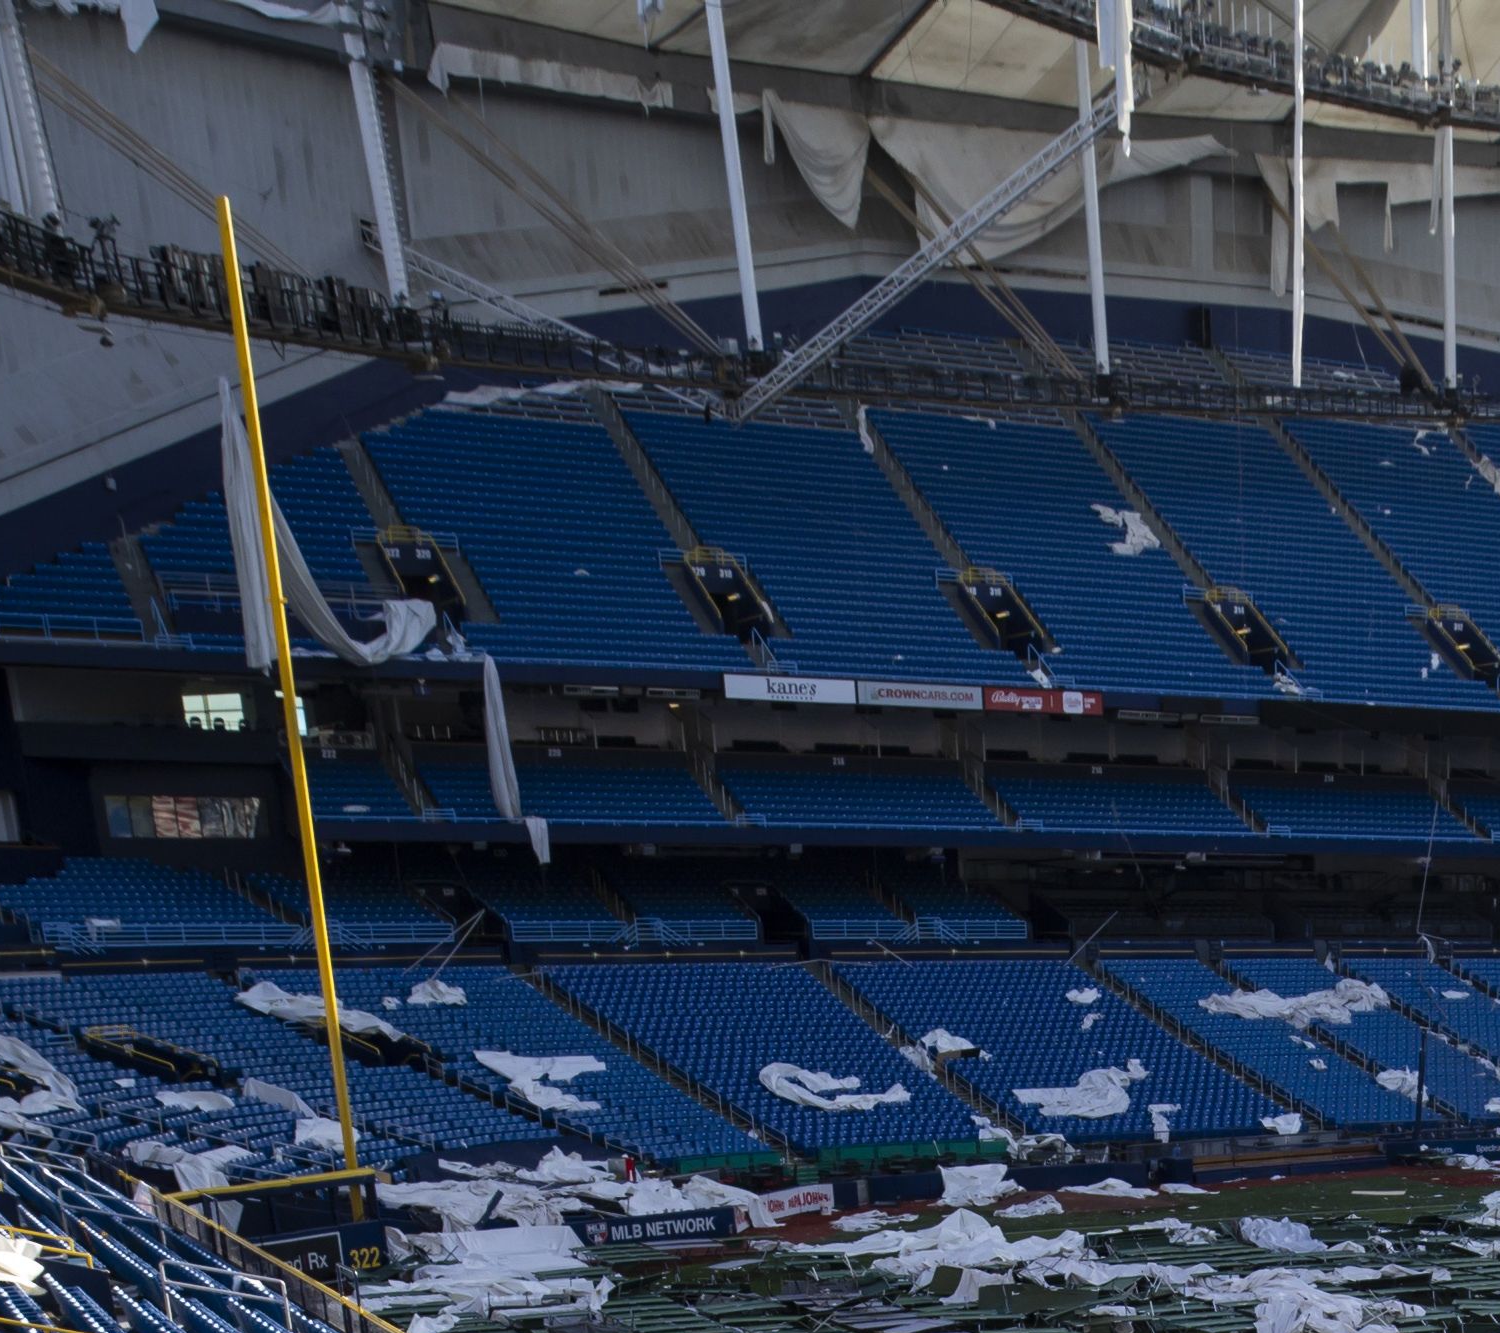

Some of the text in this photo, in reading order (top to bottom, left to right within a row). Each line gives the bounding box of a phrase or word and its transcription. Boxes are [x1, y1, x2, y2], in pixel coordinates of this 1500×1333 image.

[767, 679, 818, 695] kane's
[877, 688, 975, 702] CROWNCARS.COM
[611, 1216, 716, 1240] MLB NETWORK
[308, 1252, 328, 1270] Rx
[349, 1246, 381, 1269] 322
